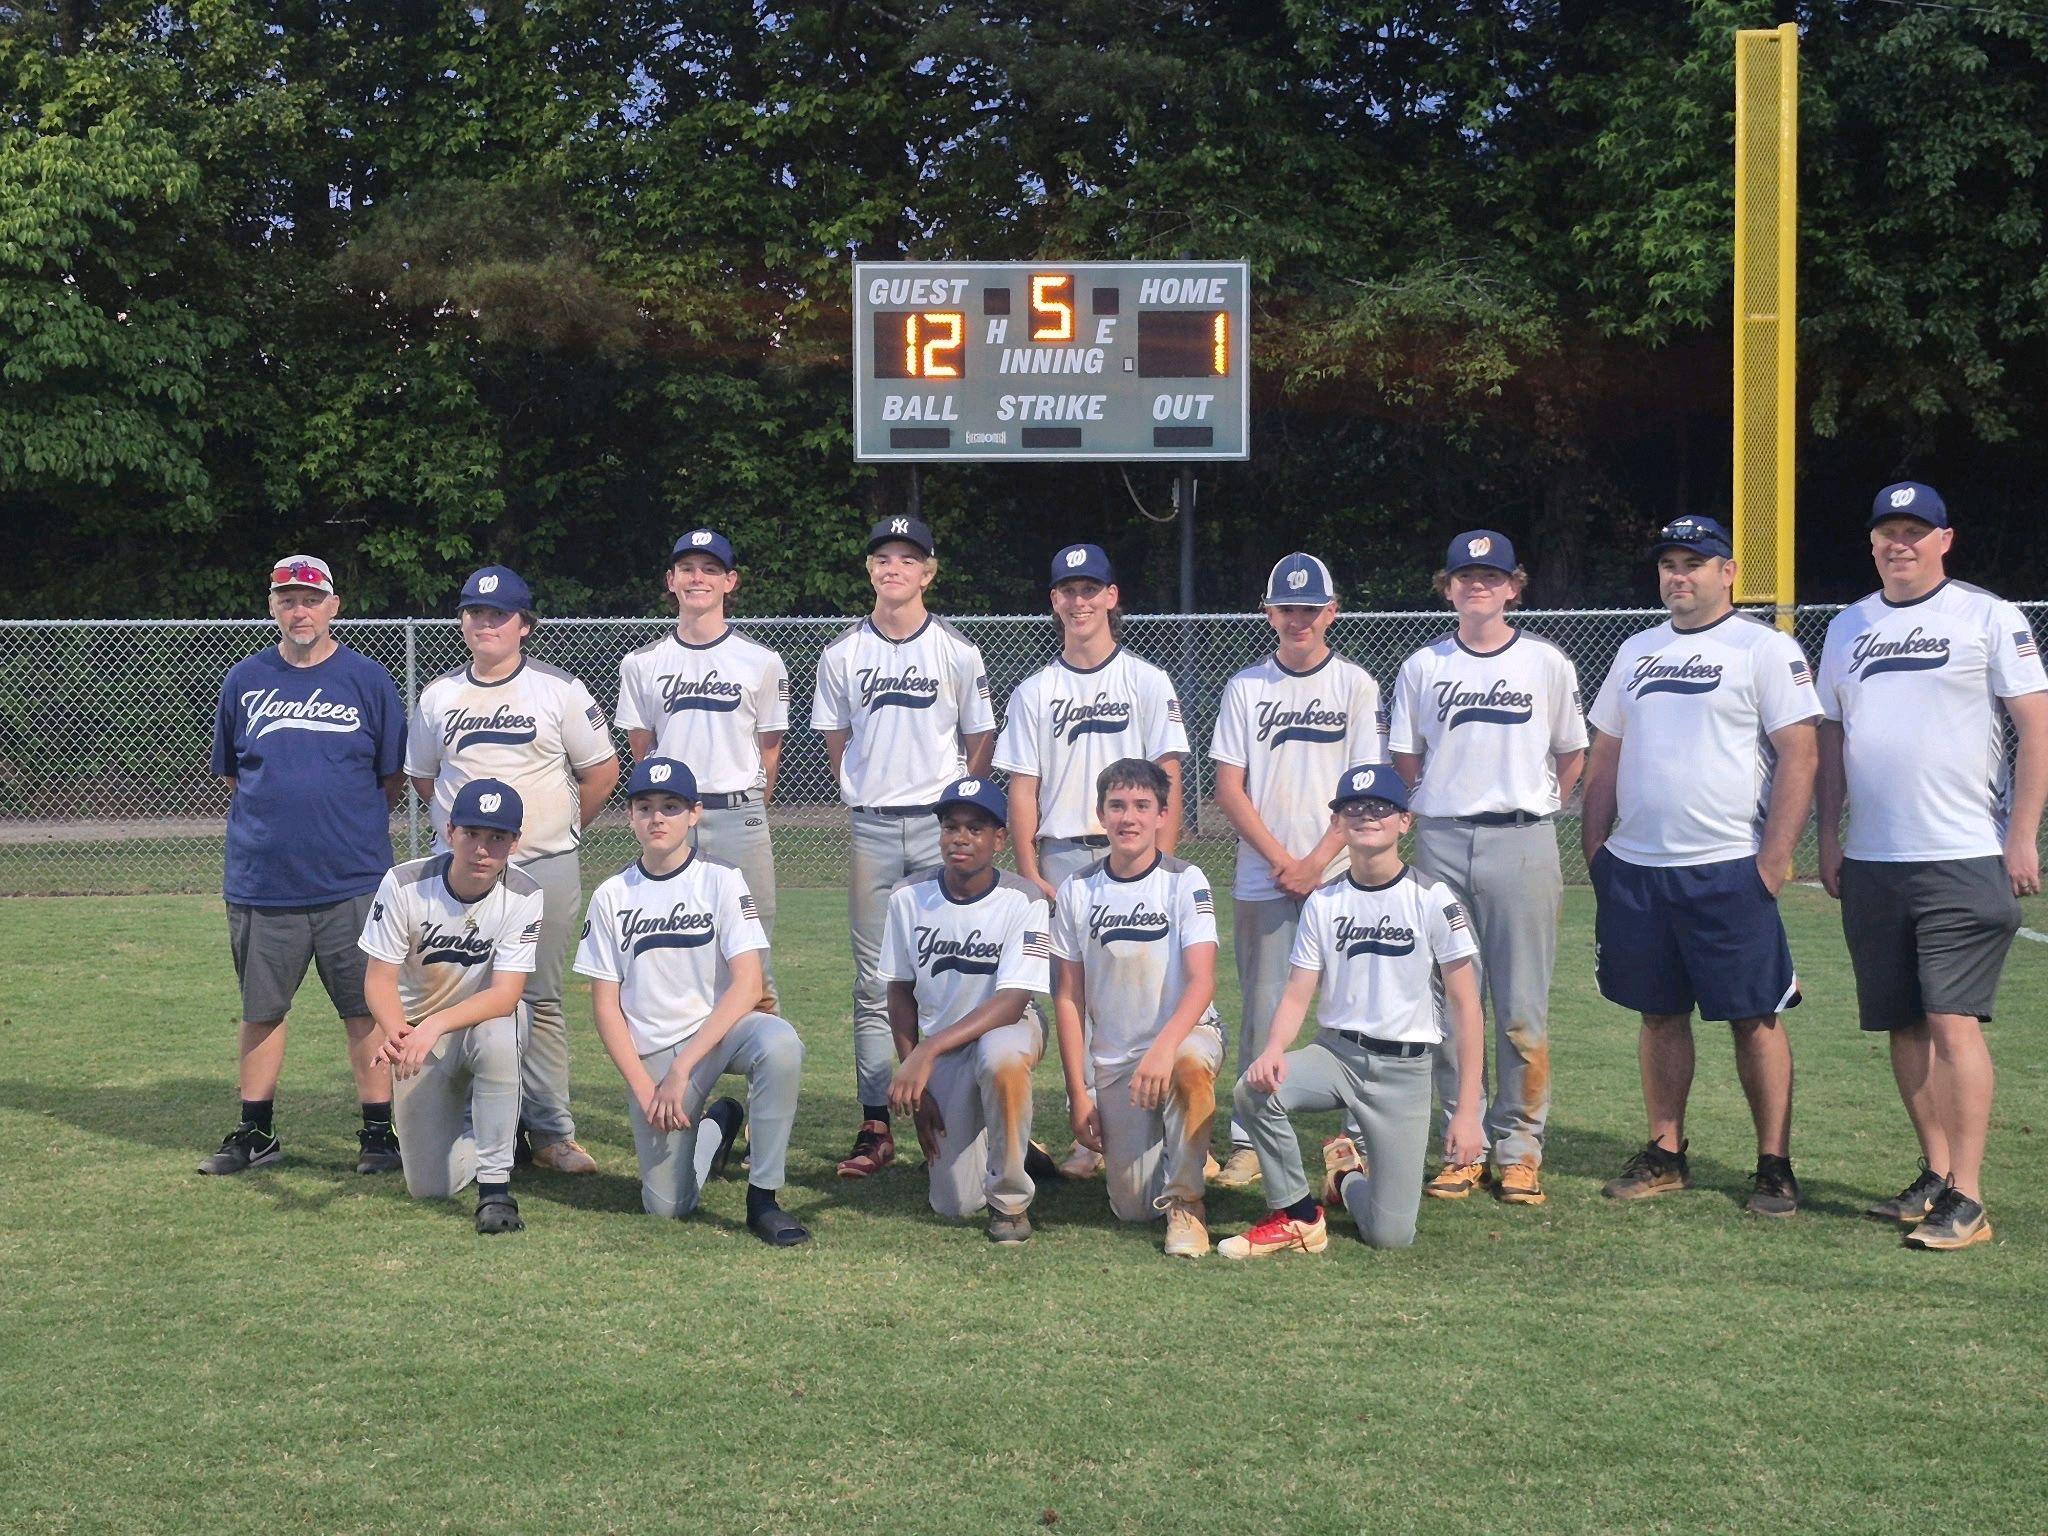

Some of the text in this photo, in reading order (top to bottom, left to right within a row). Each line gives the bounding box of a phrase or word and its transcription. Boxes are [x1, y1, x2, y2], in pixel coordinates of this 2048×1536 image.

[868, 278, 968, 305] GUEST
[1032, 276, 1071, 339] 5
[1139, 278, 1227, 304] HOME
[906, 313, 961, 376] 12
[986, 319, 1007, 344] H
[1095, 319, 1115, 344] E
[1214, 313, 1225, 375] 1
[999, 348, 1105, 374] INNING
[882, 395, 958, 421] BALL
[997, 395, 1106, 421] STRIKE
[1152, 394, 1214, 420] OUT
[890, 518, 909, 533] NY
[1848, 626, 1951, 674] Yankees
[856, 665, 940, 707] Yankees
[1626, 654, 1724, 692] Yankees
[241, 688, 360, 736] Yankees
[1050, 692, 1130, 738] Yankees
[1255, 698, 1348, 742] Yankees
[1433, 679, 1533, 723] Yankees
[443, 704, 537, 746] Yankees
[616, 902, 715, 952] Yankees
[1089, 901, 1169, 940] Yankees
[1333, 914, 1416, 952] Yankees
